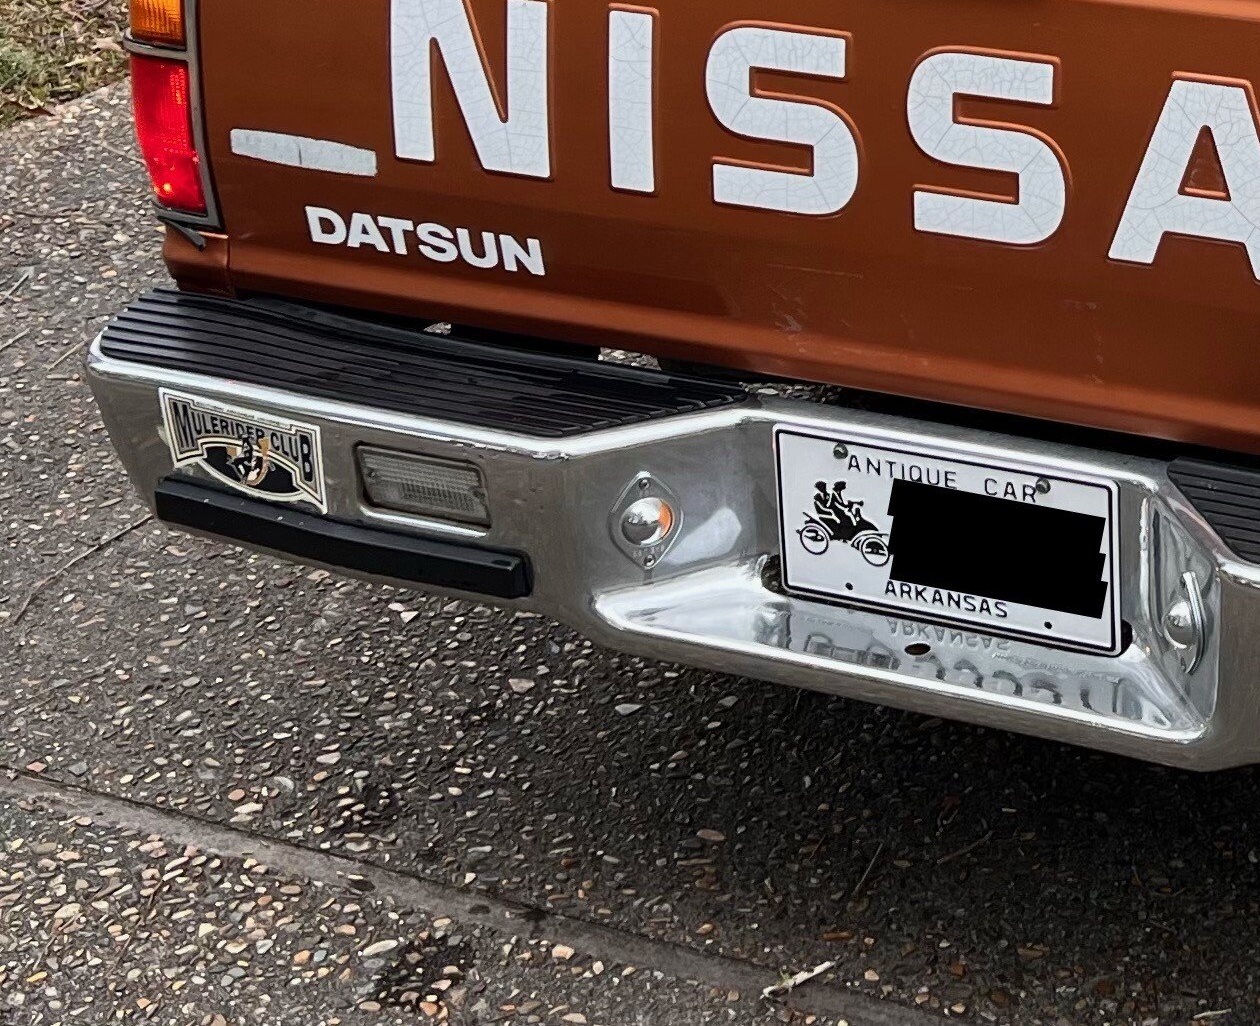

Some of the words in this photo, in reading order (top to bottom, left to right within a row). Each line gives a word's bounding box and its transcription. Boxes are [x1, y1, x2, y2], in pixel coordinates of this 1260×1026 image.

[304, 205, 546, 276] DATSUN
[173, 401, 266, 448] MULERIDER
[270, 432, 314, 483] CLUB
[847, 454, 958, 491] ANTIQUE
[983, 477, 1038, 504] CAR
[884, 579, 1009, 619] ARKANSAS
